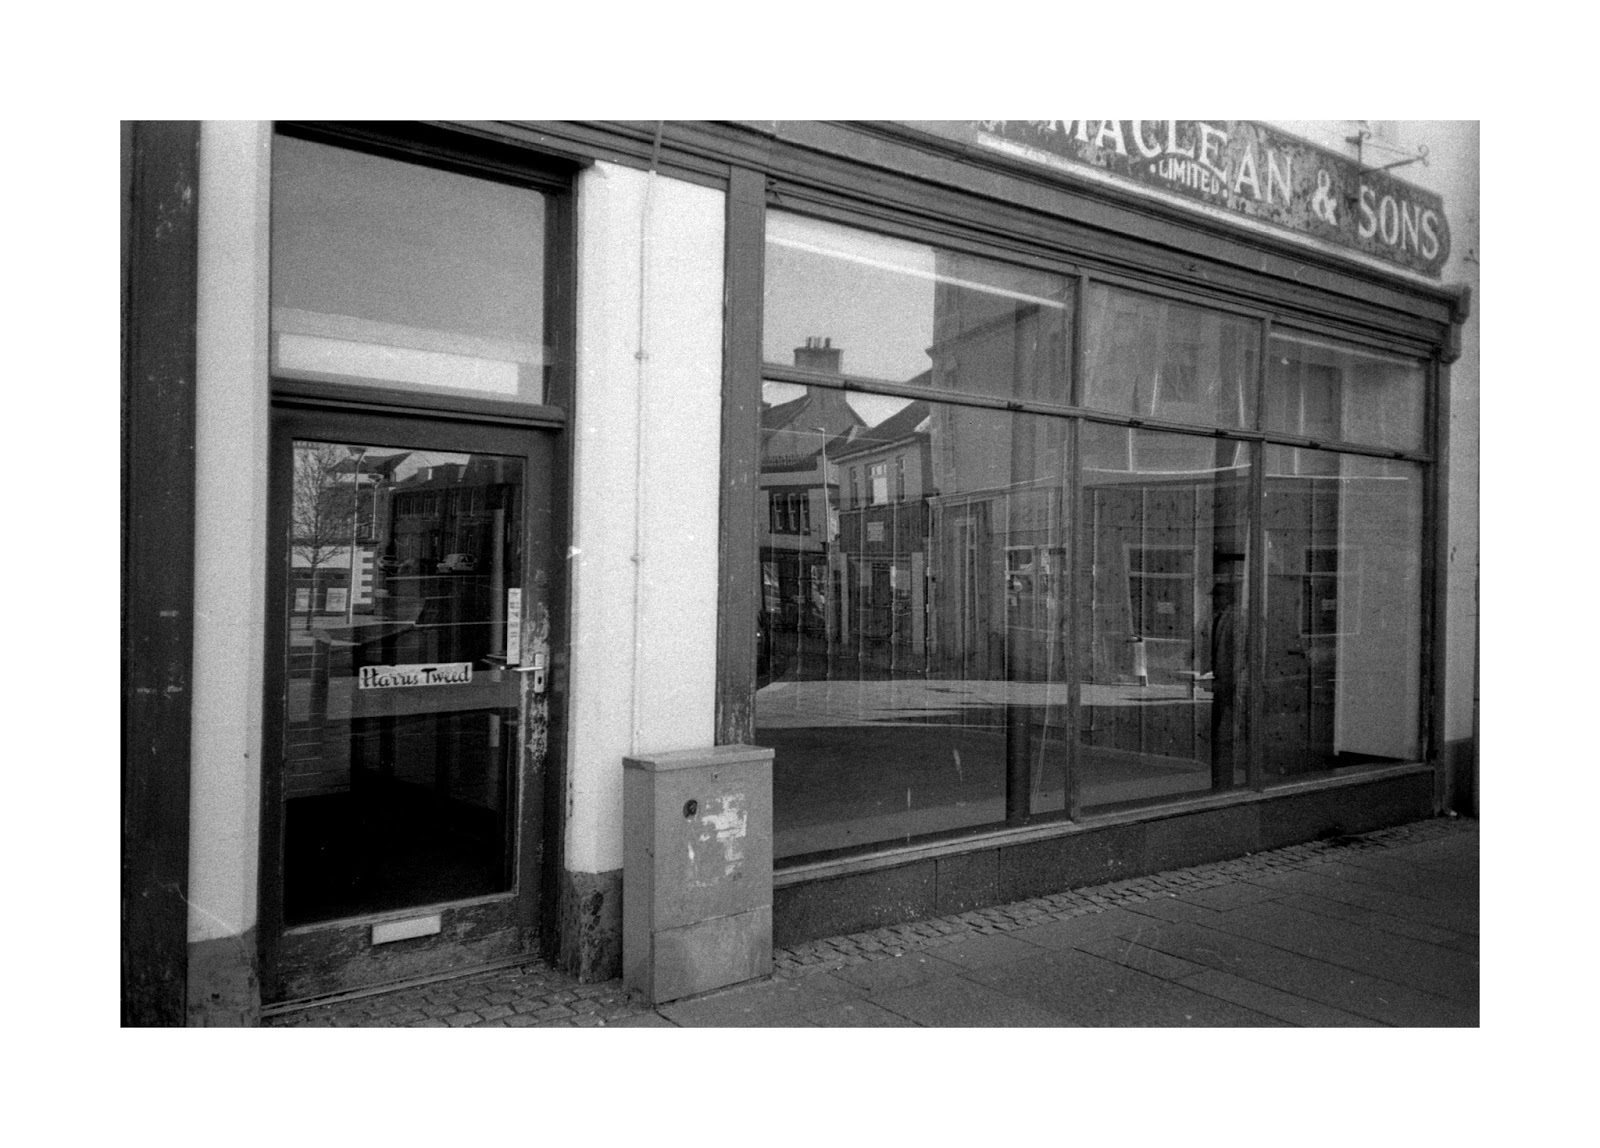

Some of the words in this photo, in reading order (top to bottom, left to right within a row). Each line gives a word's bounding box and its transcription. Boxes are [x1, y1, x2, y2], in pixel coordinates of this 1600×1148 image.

[1046, 120, 1292, 206] ACLEAN
[1312, 169, 1337, 225] &
[1358, 185, 1439, 260] SONS
[361, 668, 418, 687] Harris
[421, 665, 468, 684] Tweed
